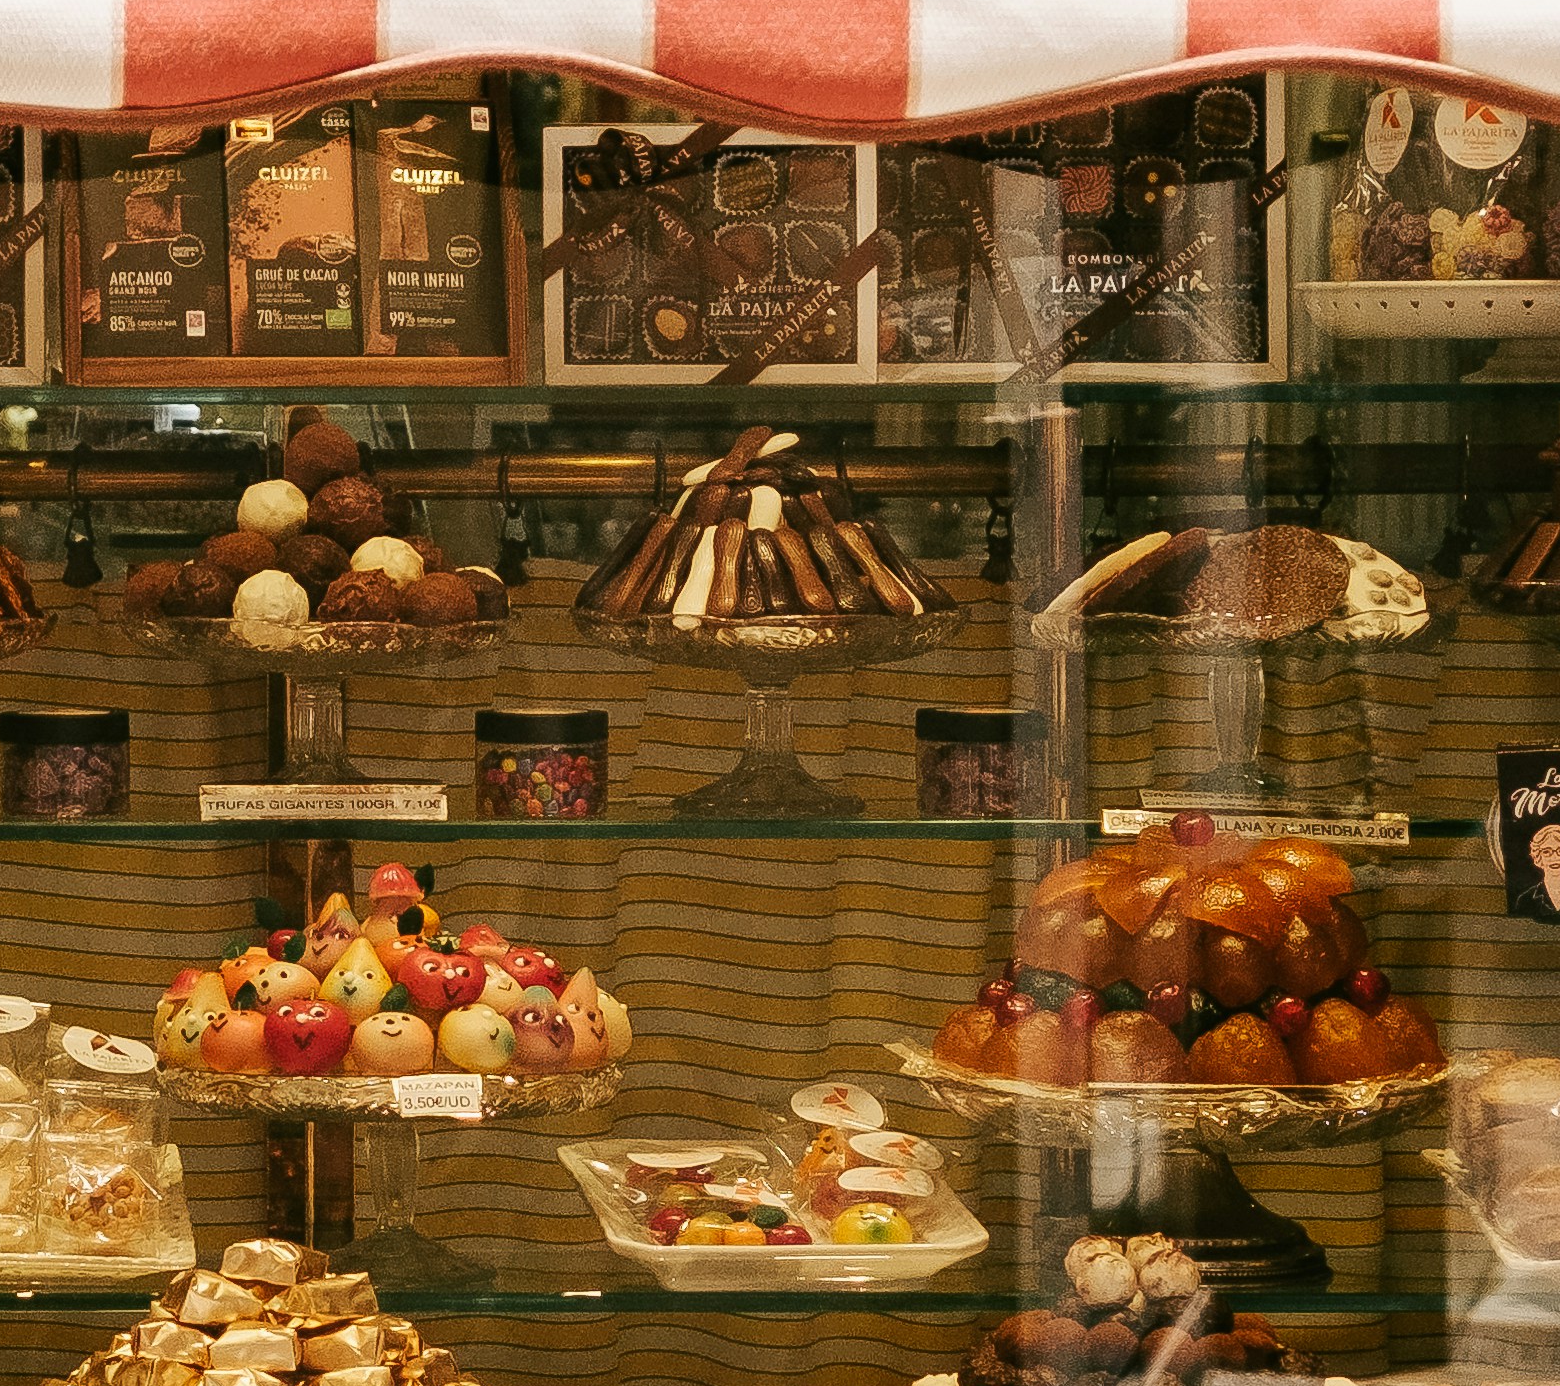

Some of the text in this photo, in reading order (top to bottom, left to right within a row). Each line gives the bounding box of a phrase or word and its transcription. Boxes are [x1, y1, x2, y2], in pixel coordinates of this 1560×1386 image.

[259, 166, 333, 181] CLUIZEL
[391, 168, 464, 185] CLUIZEL
[109, 271, 173, 286] ARCANGO
[286, 269, 300, 281] DE
[303, 269, 339, 281] CACAO
[387, 271, 464, 288] NOIR INFINI
[1050, 275, 1081, 289] LA
[206, 800, 266, 811] TRUFAS
[269, 799, 345, 811] GIGANTES
[1267, 823, 1275, 834] Y
[401, 1080, 476, 1092] MAZAPAN
